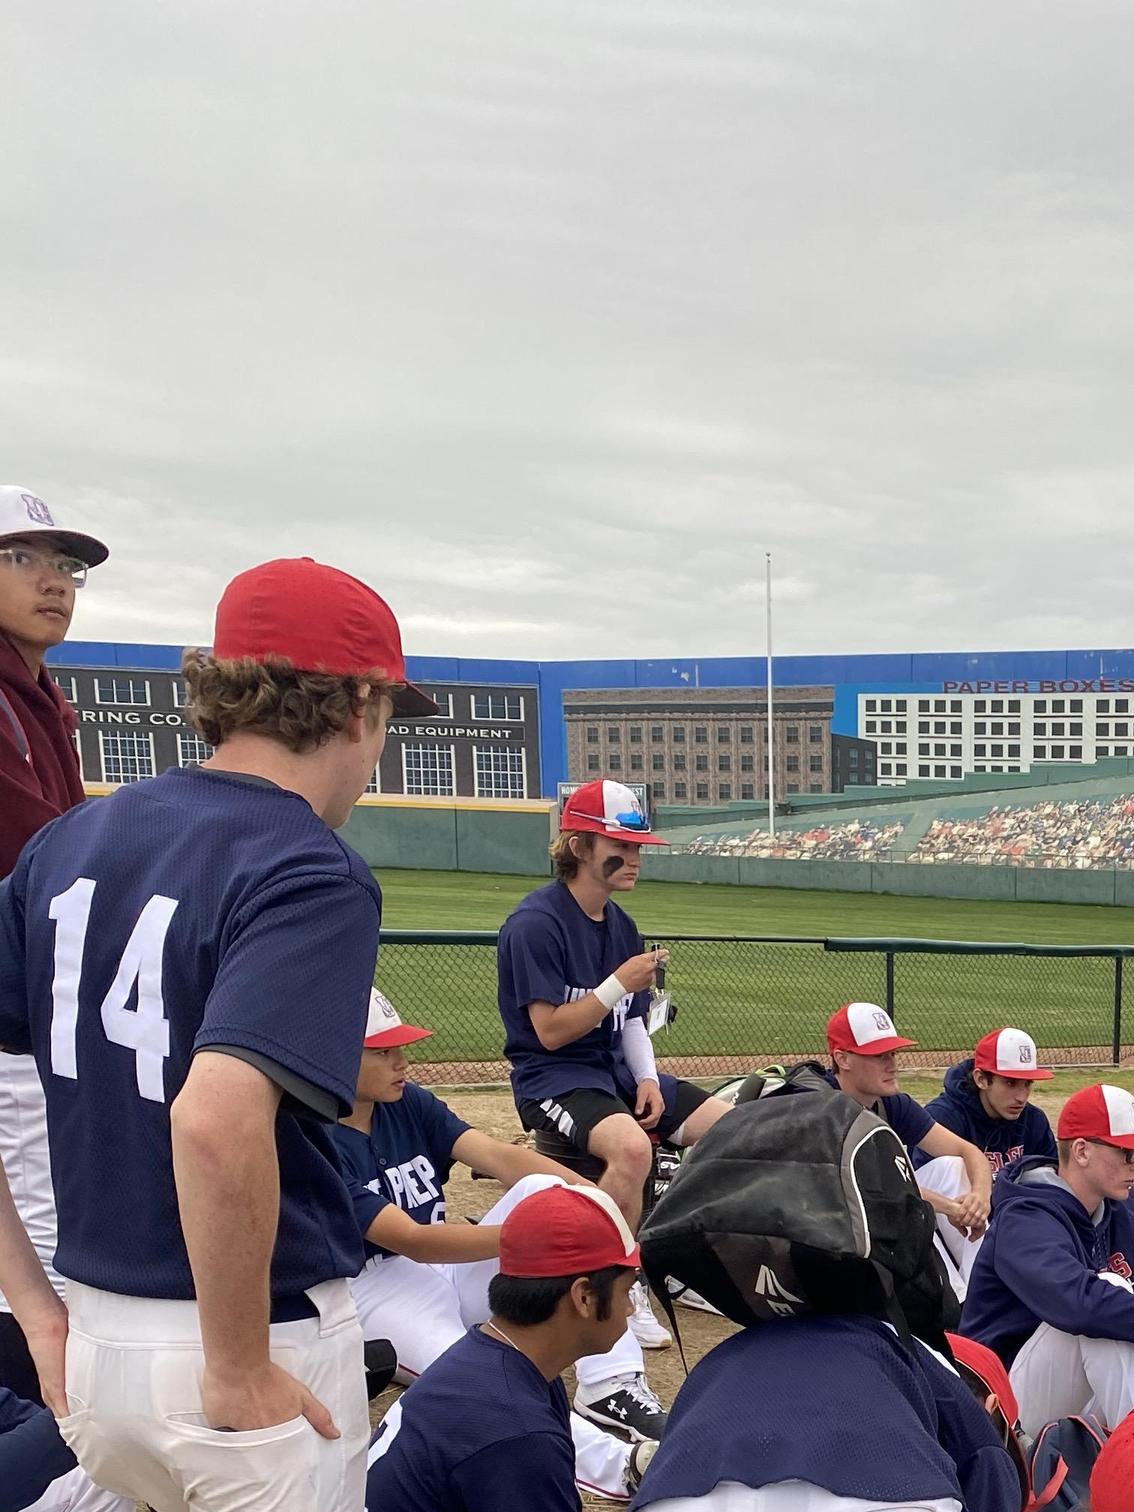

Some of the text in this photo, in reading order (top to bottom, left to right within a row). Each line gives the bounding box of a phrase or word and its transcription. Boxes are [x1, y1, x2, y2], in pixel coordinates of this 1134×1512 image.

[944, 680, 1029, 694] PAPER
[74, 710, 187, 726] RING CO.
[384, 725, 512, 739] AD EQUIPMENT
[48, 877, 179, 1104] 14
